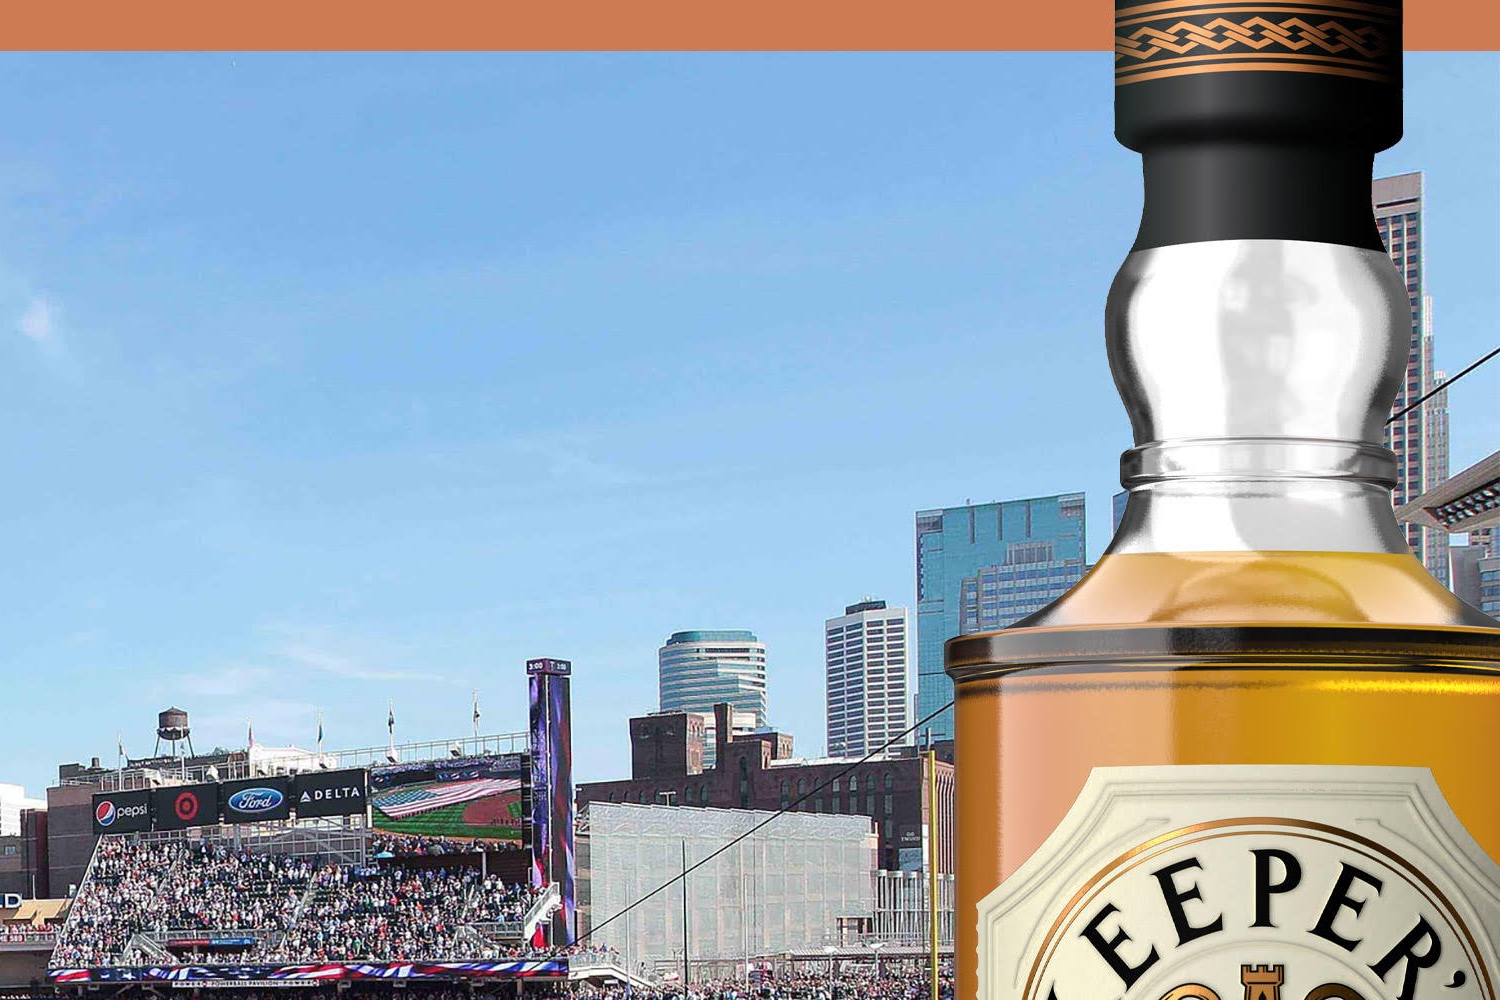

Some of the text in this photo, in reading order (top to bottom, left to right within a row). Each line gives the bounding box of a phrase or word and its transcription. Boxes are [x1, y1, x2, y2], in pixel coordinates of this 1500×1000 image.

[238, 792, 273, 809] Ford
[315, 787, 360, 801] DELTA
[116, 803, 148, 820] pepsi
